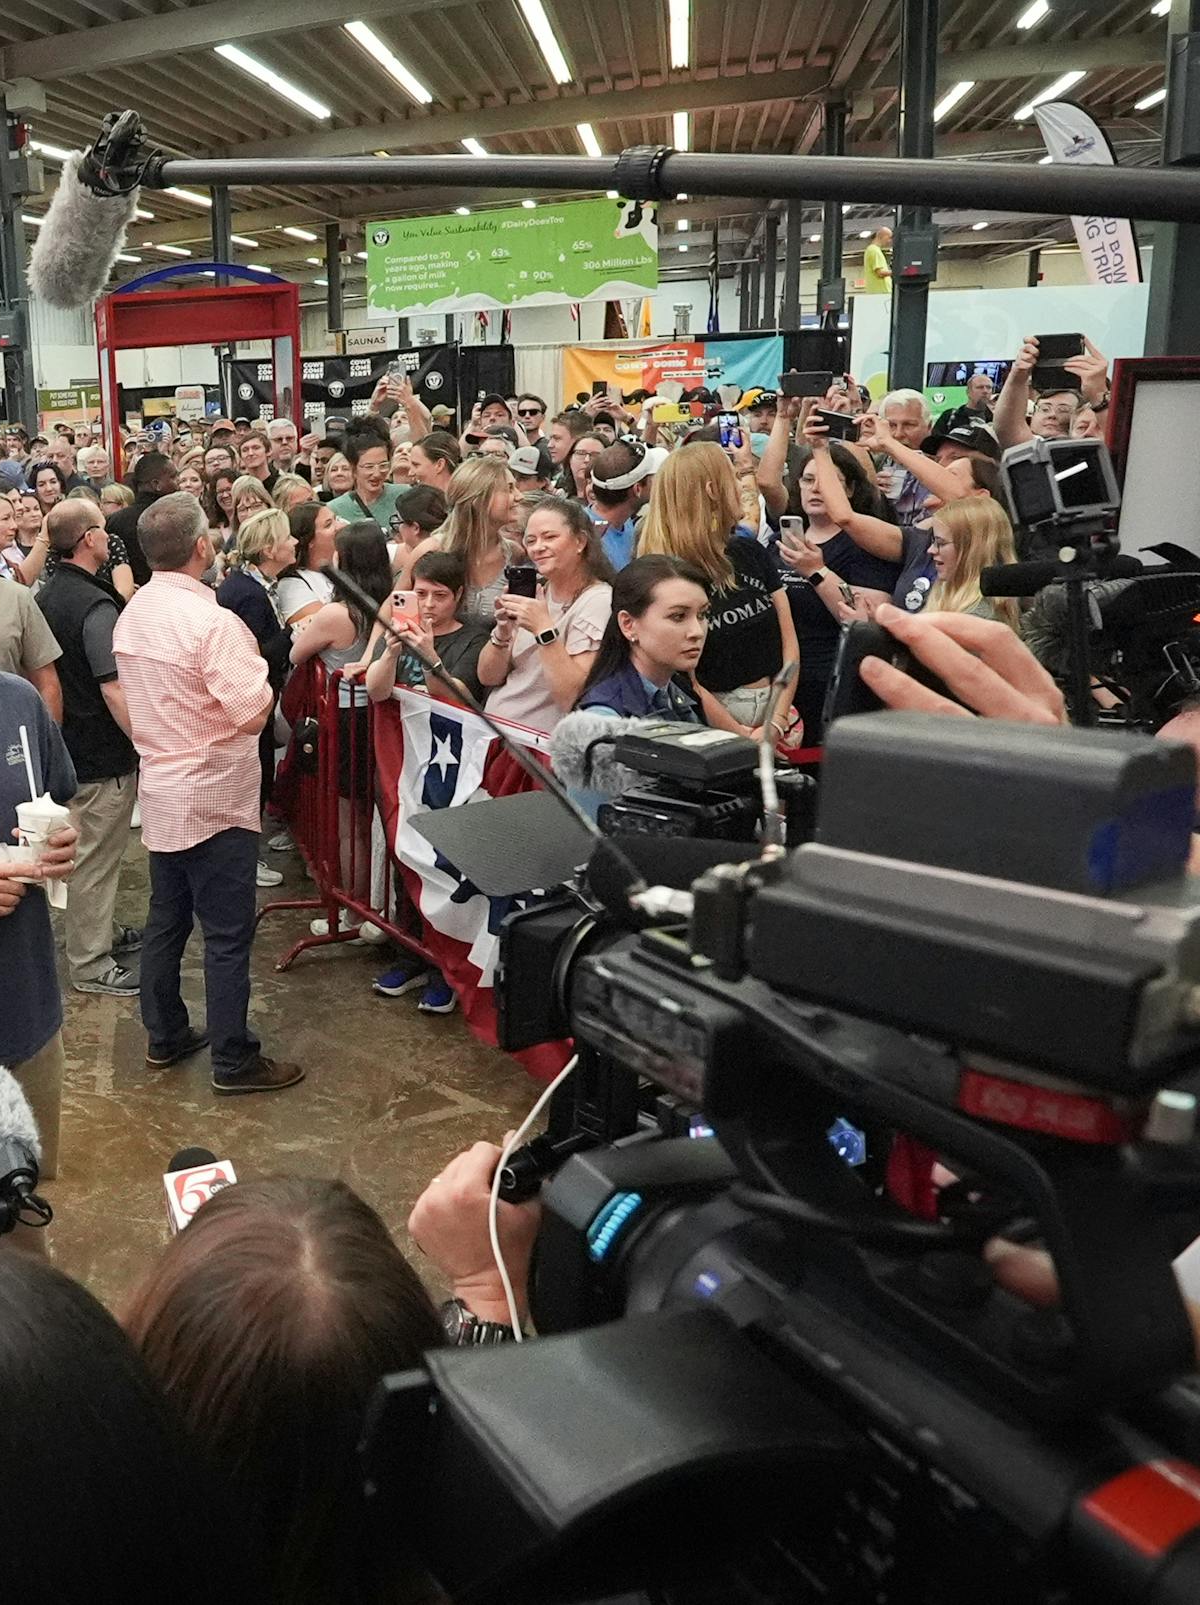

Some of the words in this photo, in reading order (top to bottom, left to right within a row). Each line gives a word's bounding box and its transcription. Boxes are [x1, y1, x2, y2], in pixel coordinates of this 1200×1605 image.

[501, 215, 565, 229] #DairyDoesToo
[571, 239, 593, 250] 65%
[491, 248, 510, 257] 63%
[385, 254, 428, 265] Compared
[583, 260, 600, 270] 306
[602, 257, 634, 269] Million
[636, 255, 653, 265] Lbs
[385, 264, 408, 274] years
[409, 262, 427, 272] ago,
[428, 260, 460, 270] making
[391, 273, 417, 285] gallon
[418, 272, 428, 280] of
[429, 270, 446, 279] milk
[533, 271, 554, 281] 90%
[385, 284, 403, 292] now
[347, 336, 386, 346] SAUNAS
[397, 352, 419, 360] COWS
